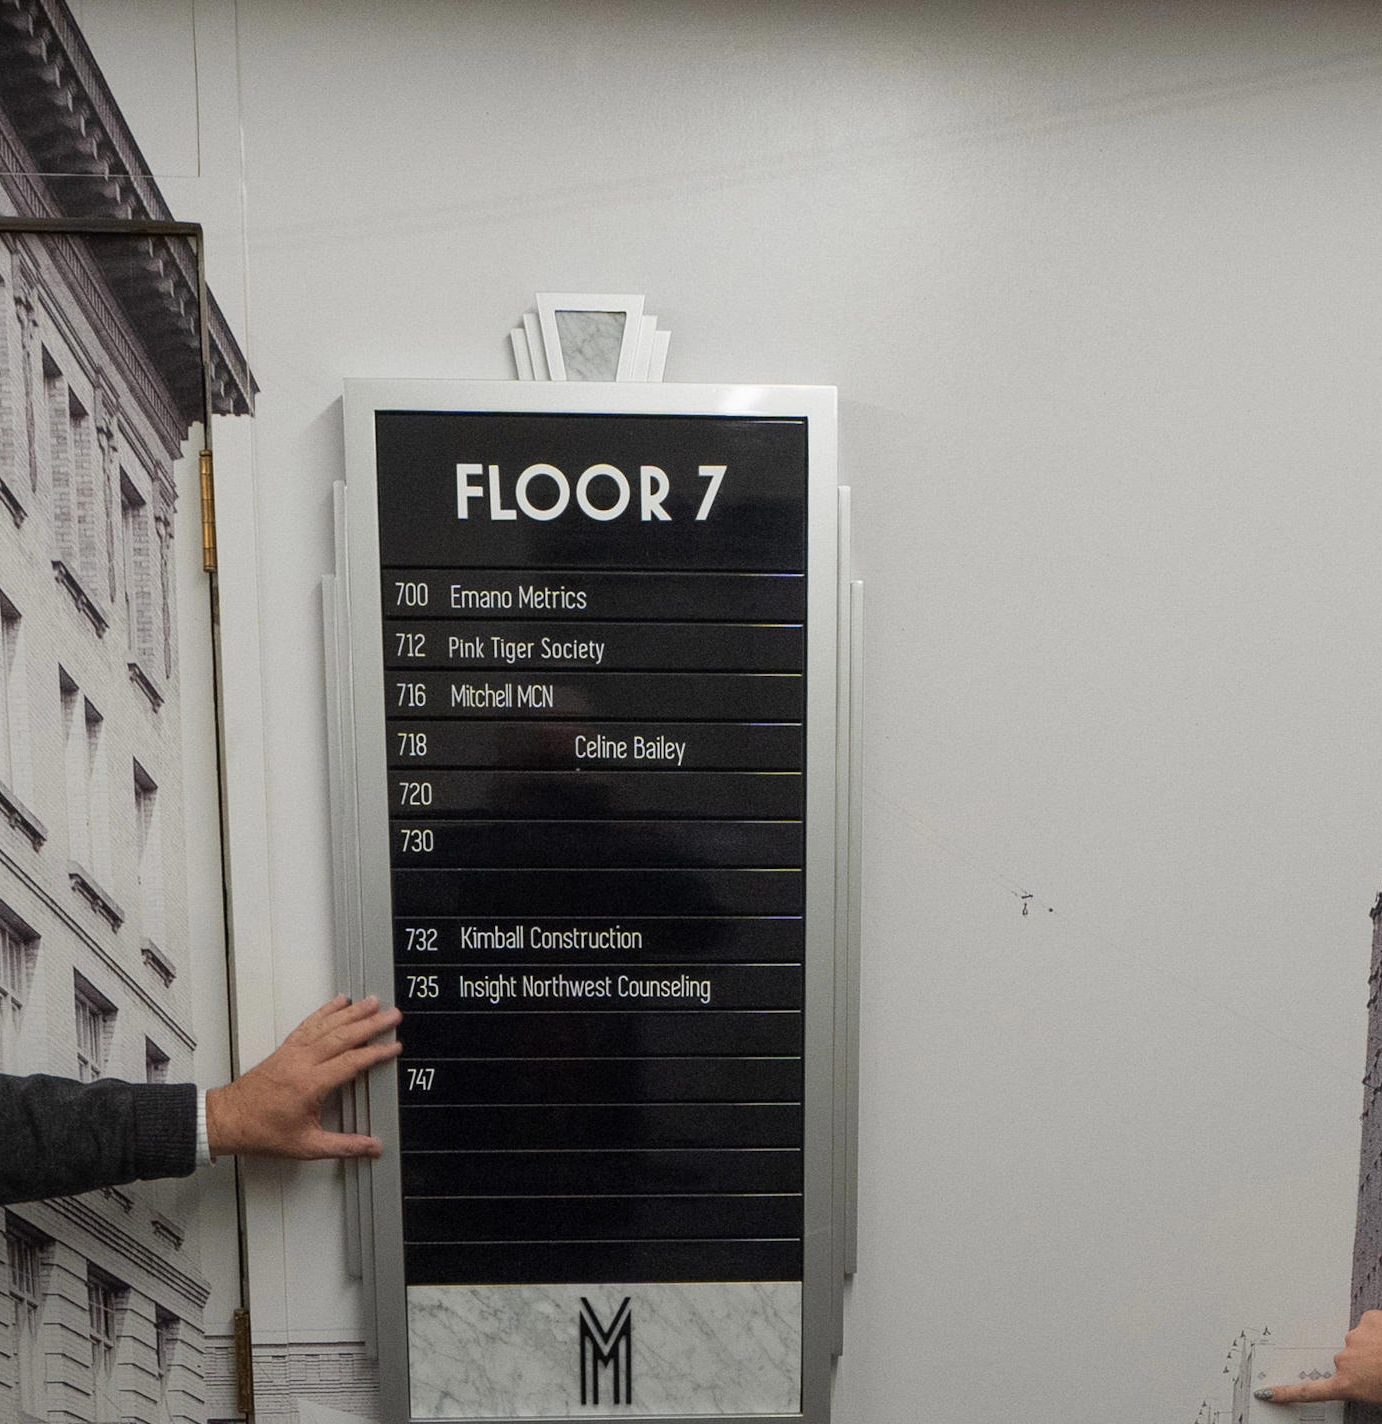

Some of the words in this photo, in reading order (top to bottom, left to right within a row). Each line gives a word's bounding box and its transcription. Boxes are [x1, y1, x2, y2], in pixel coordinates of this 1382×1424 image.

[456, 463, 672, 521] FLOOR
[695, 465, 728, 521] 7
[395, 582, 429, 607] 700
[450, 584, 513, 609] Emano
[518, 585, 587, 610] Metrics
[395, 633, 426, 657] 712
[448, 636, 485, 658] Pink
[490, 636, 535, 664] Tiger
[541, 637, 605, 665] Society
[396, 683, 427, 707] 716
[451, 683, 513, 708] Mitchell
[517, 684, 554, 708] MCN
[398, 732, 427, 756] 718
[575, 734, 628, 759] Celine
[633, 735, 686, 767] Bailey
[399, 782, 433, 806] 720
[401, 829, 434, 852] 730
[405, 928, 438, 951] 732
[461, 925, 524, 949] Kimball
[530, 925, 642, 949] Construction
[407, 975, 439, 998] 735
[459, 974, 517, 1004] Insight
[522, 974, 612, 997] Northwest
[618, 974, 711, 1004] Counseling
[407, 1068, 435, 1091] 747
